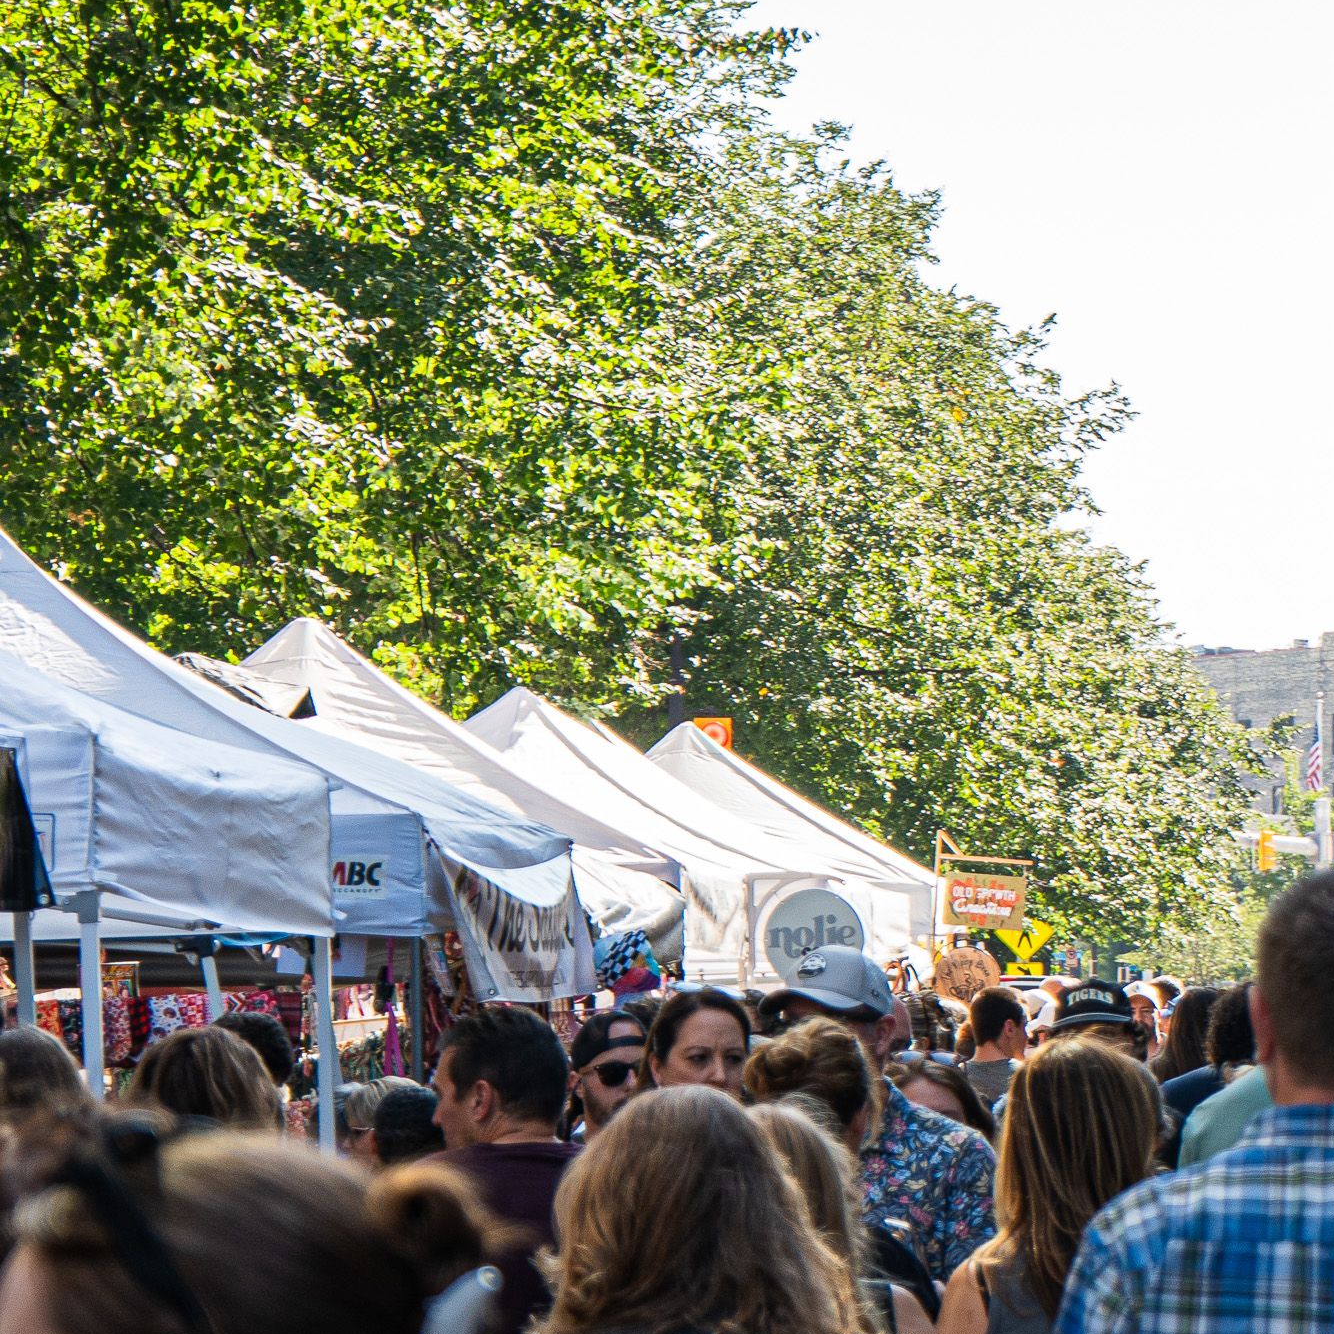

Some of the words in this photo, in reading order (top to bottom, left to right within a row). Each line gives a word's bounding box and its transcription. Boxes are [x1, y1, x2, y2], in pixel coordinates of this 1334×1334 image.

[333, 861, 382, 886] ABC
[952, 885, 974, 898] OLD
[766, 914, 857, 959] nolie
[1067, 987, 1114, 1006] TIGERS
